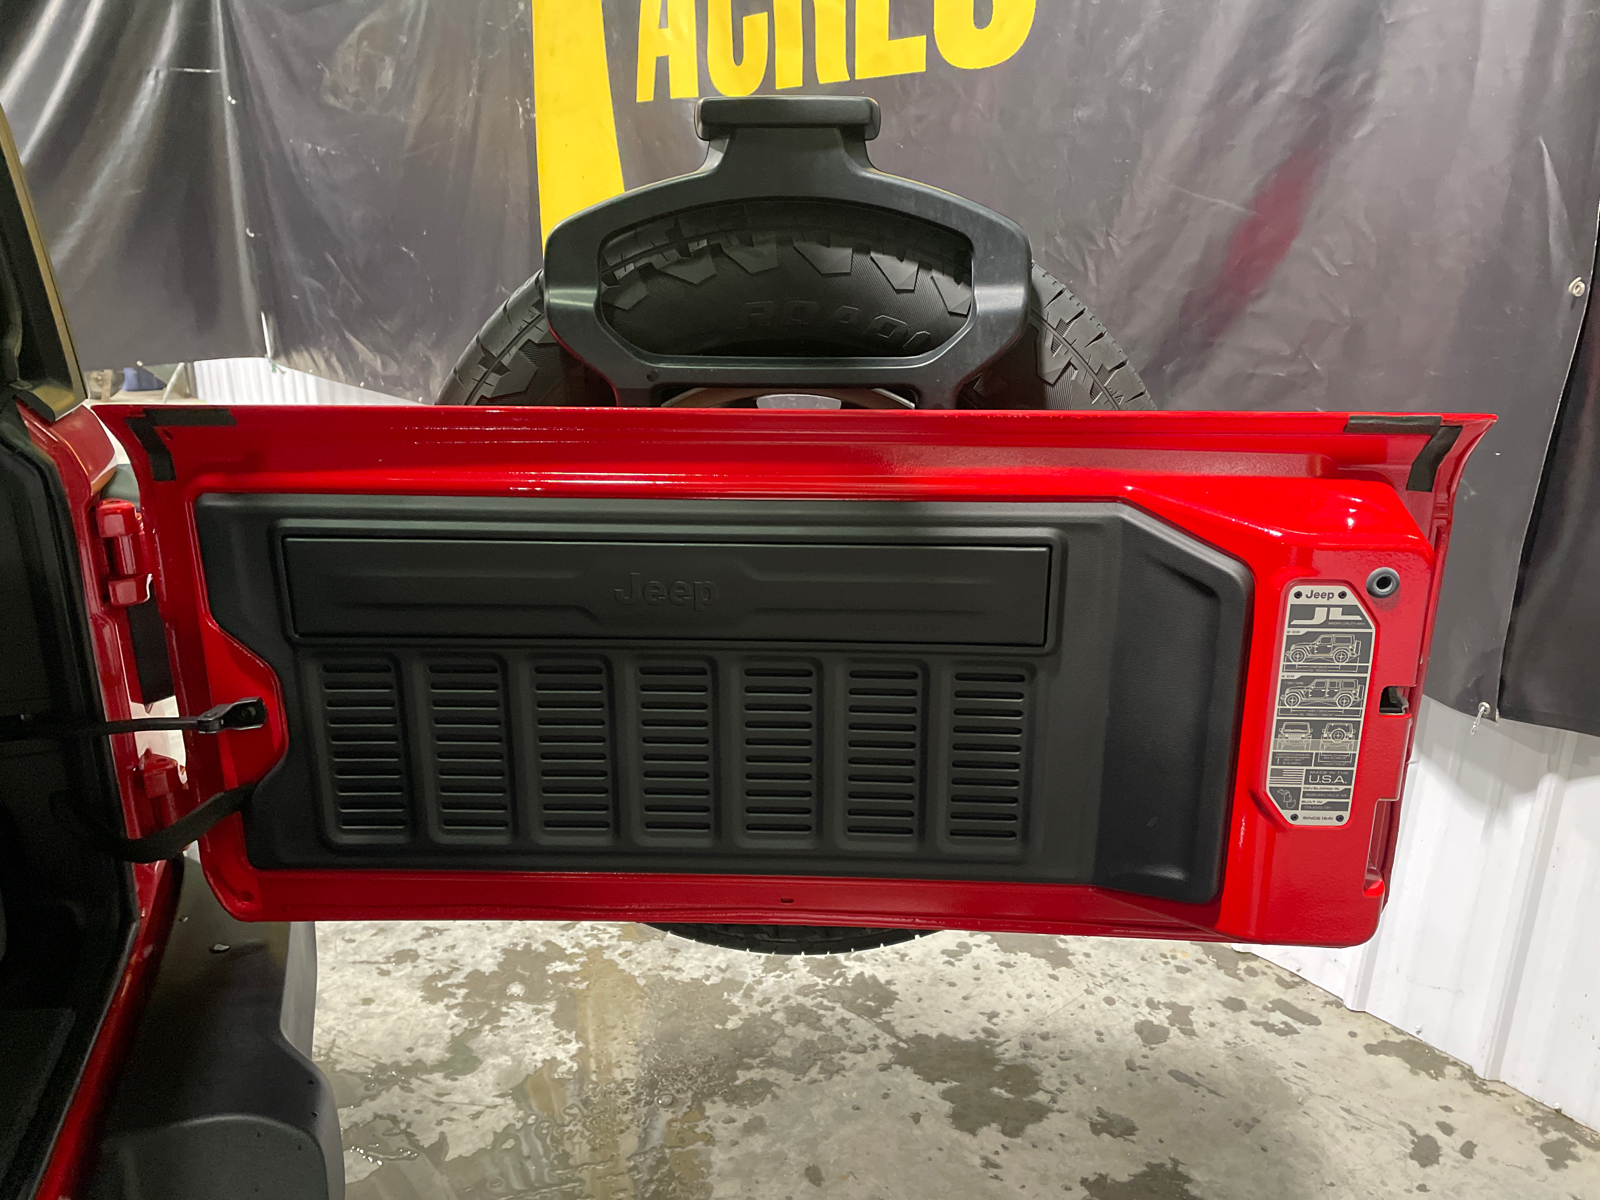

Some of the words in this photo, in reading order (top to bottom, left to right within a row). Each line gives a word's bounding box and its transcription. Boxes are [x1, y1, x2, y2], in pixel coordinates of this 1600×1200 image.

[613, 572, 719, 612] Jeep
[1305, 589, 1335, 601] Jeep
[1290, 607, 1363, 625] JL
[1308, 774, 1348, 784] U.S.A.
